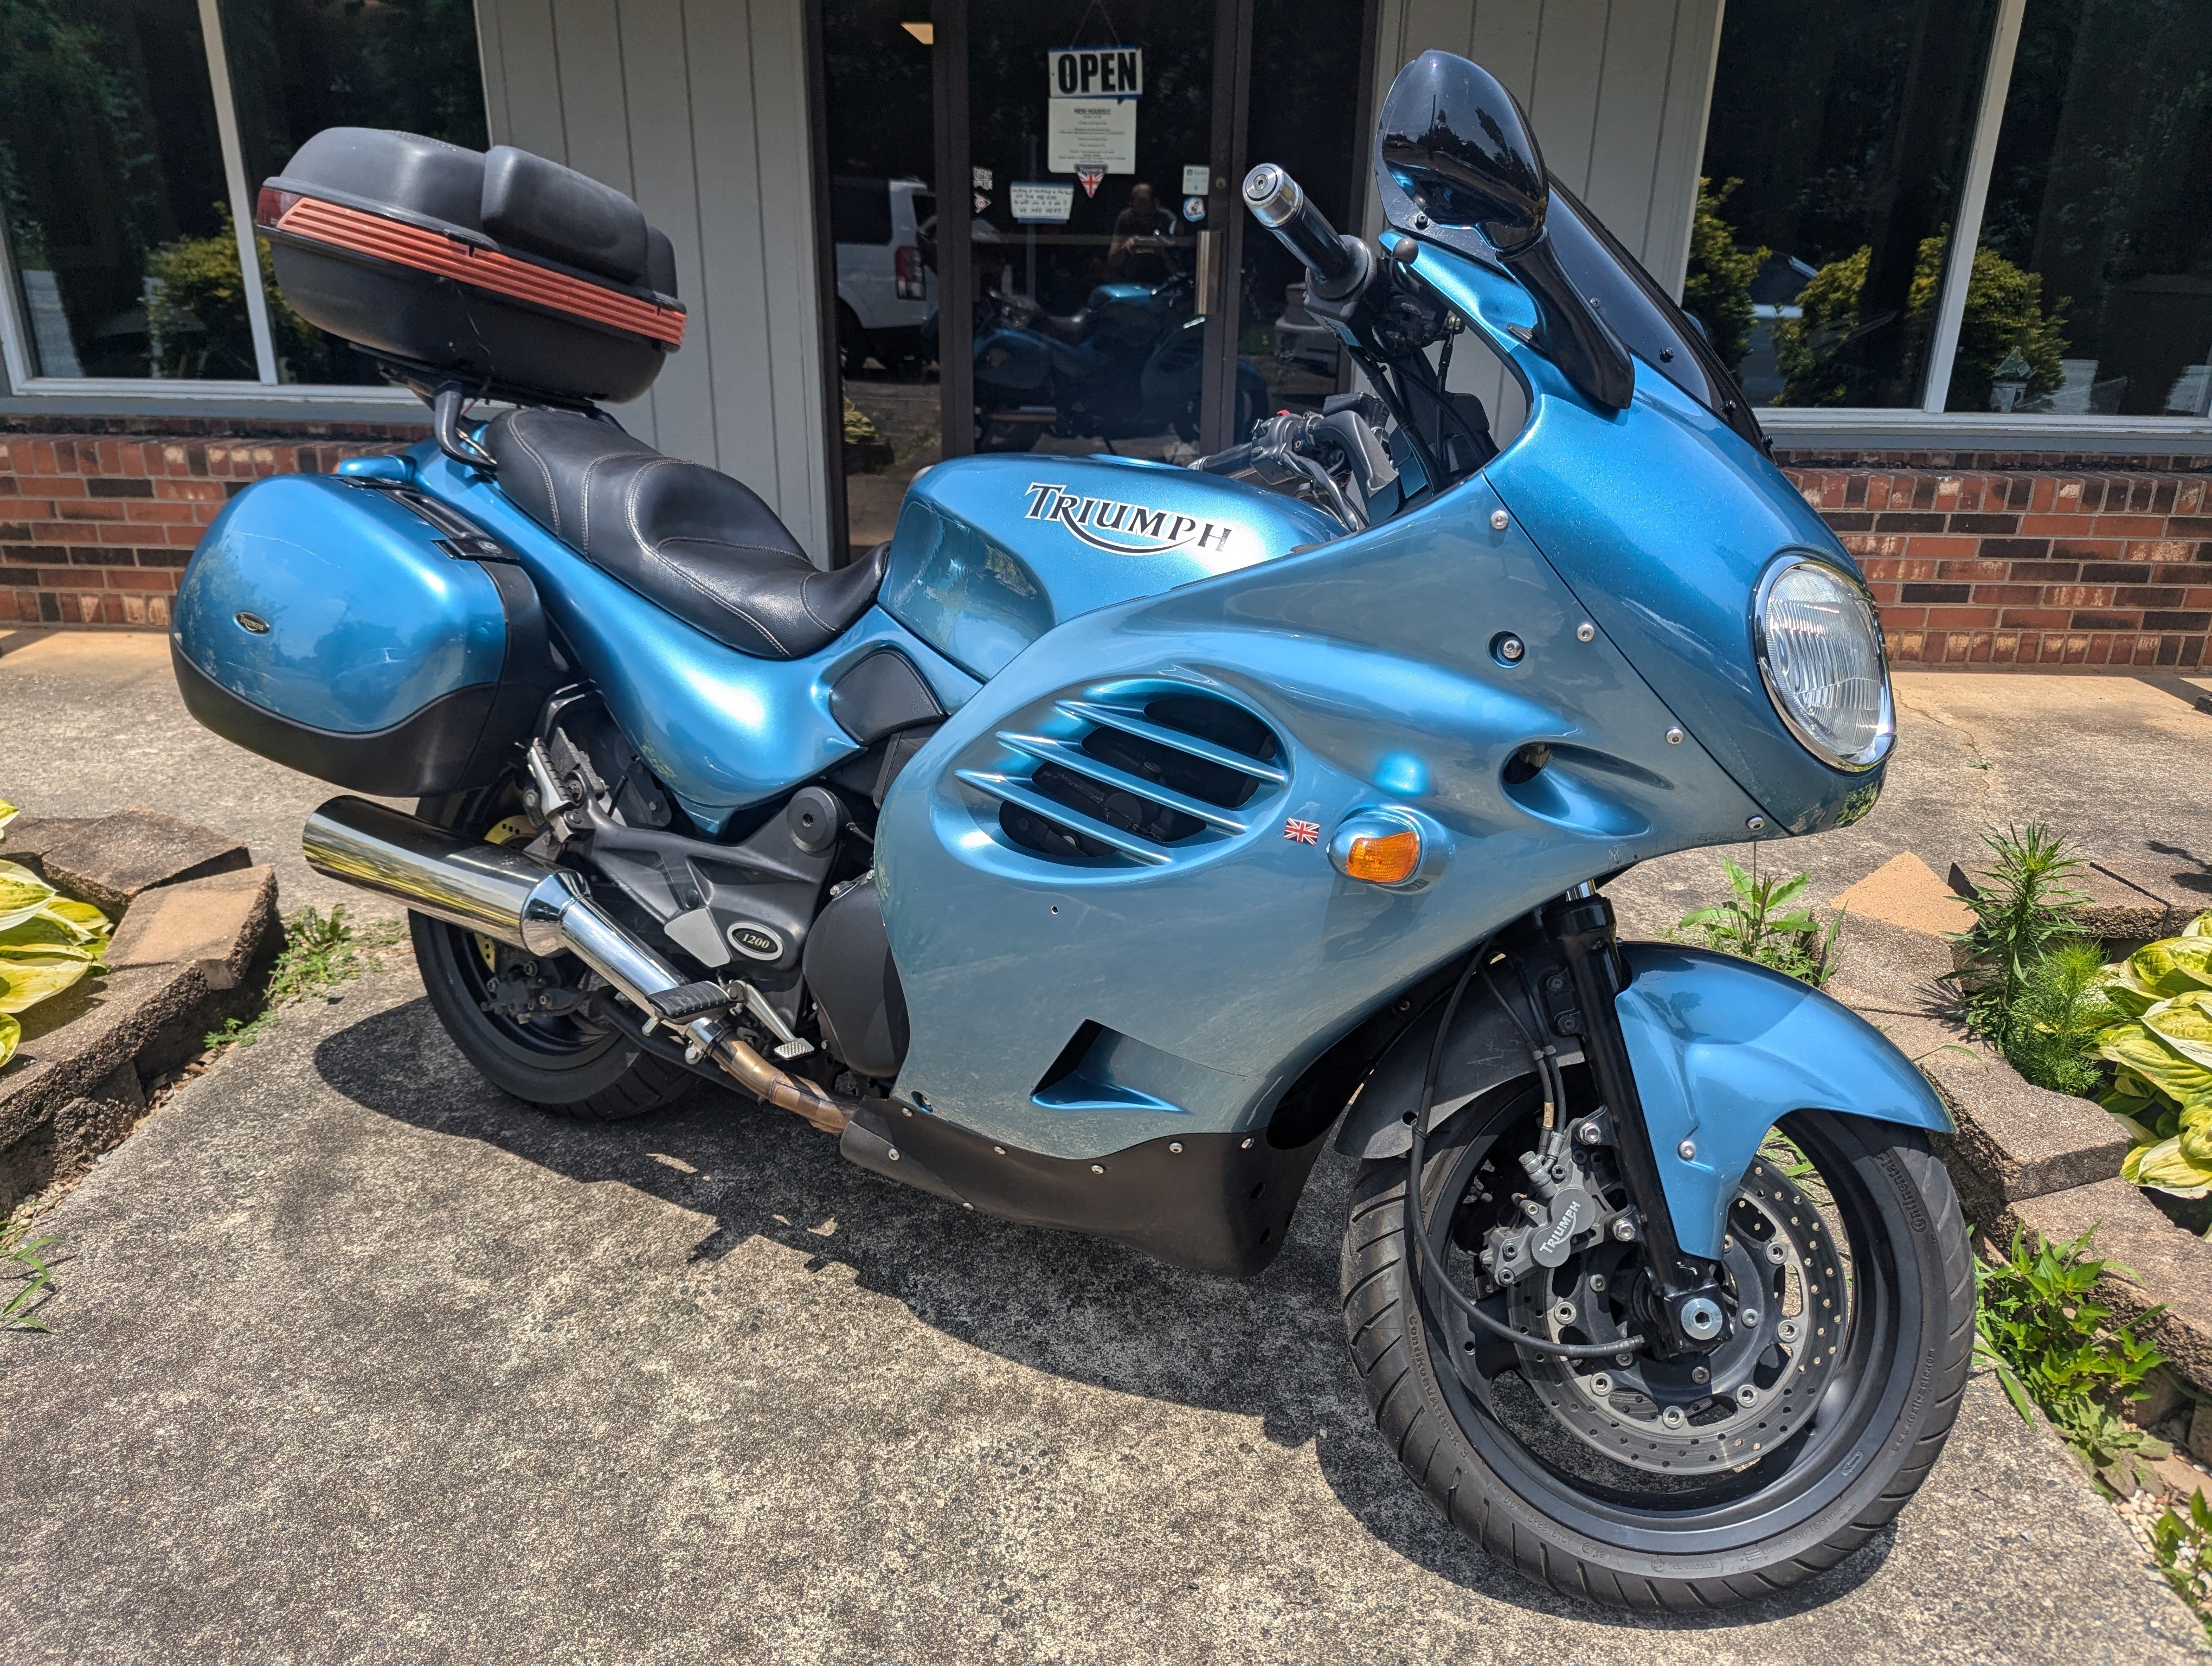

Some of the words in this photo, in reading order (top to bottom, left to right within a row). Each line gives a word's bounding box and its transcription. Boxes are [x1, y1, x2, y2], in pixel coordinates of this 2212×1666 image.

[1058, 53, 1136, 94] OPEN
[1025, 482, 1232, 554] TRIUMPH
[742, 933, 770, 949] 1200
[1539, 1201, 1581, 1254] TRIUMPH
[1461, 1447, 1469, 1458] 3
